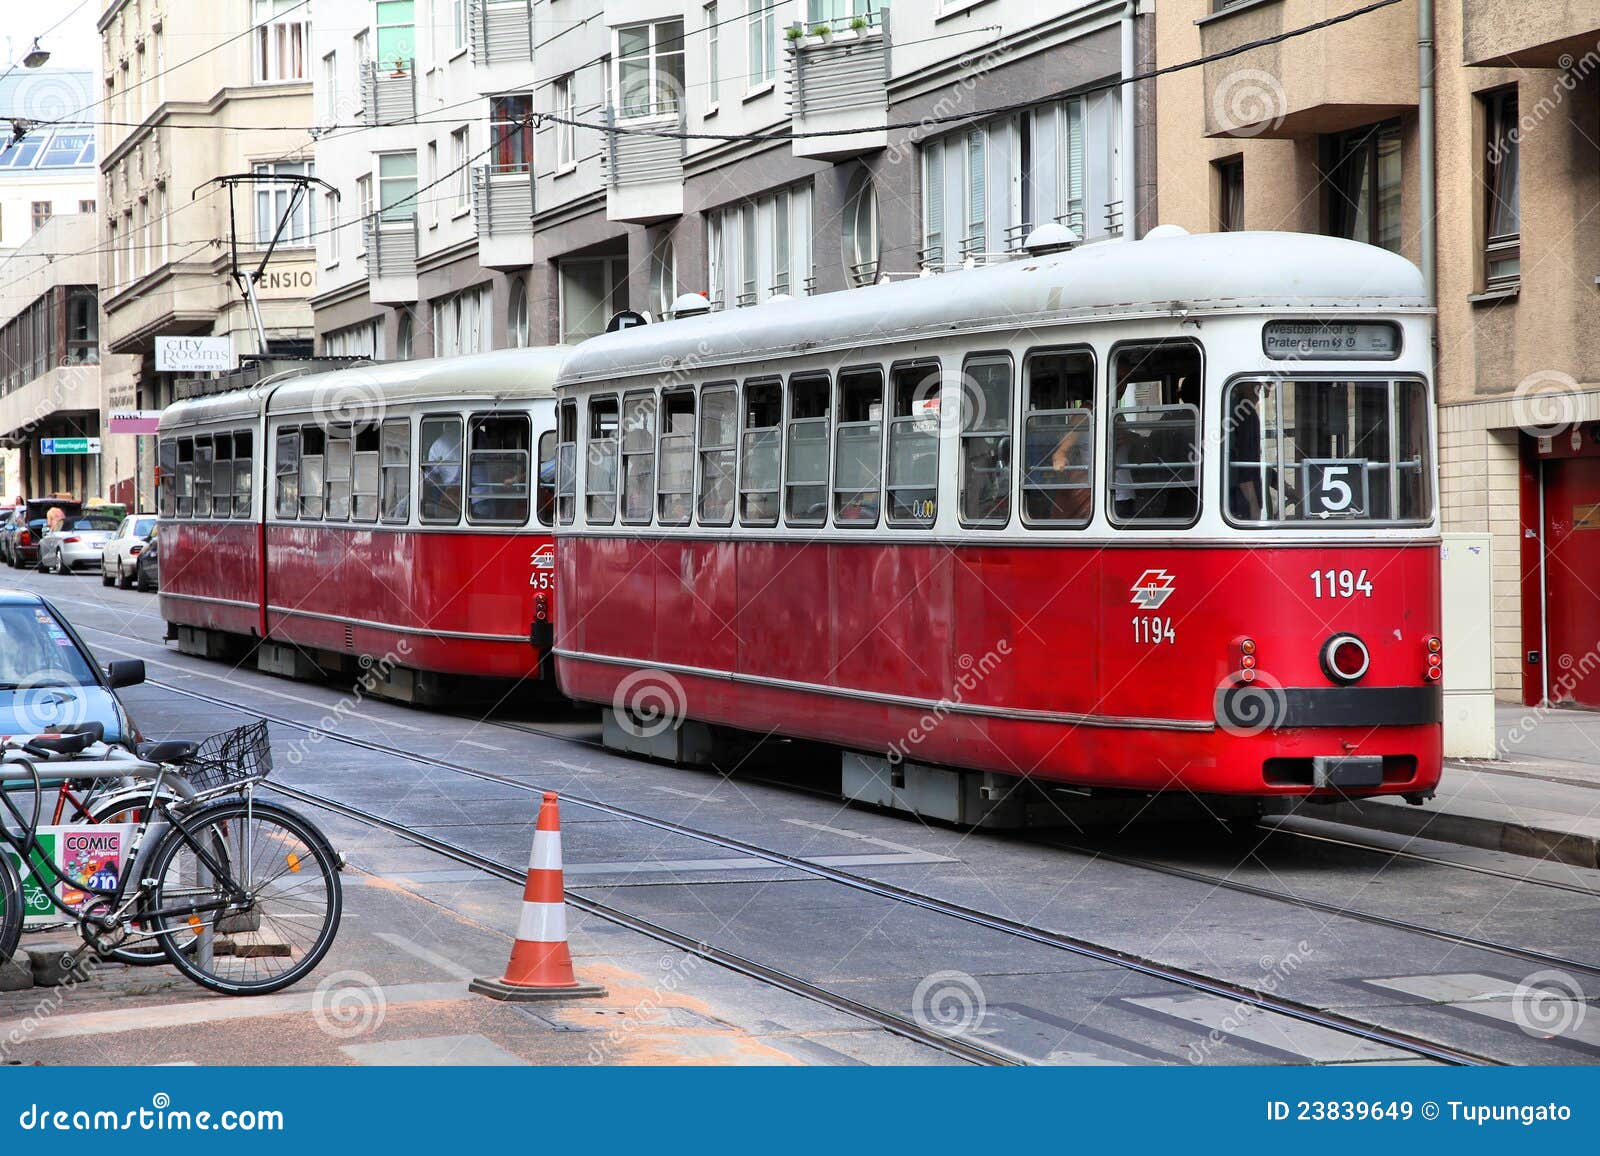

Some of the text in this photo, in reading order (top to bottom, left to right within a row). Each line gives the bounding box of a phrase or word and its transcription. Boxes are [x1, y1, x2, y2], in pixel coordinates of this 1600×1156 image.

[251, 271, 317, 289] ENSIO
[1267, 336, 1330, 348] Praterstern
[1320, 466, 1352, 511] 5
[1310, 568, 1374, 599] 1194
[1131, 616, 1176, 644] 1194
[66, 836, 118, 850] COMIC
